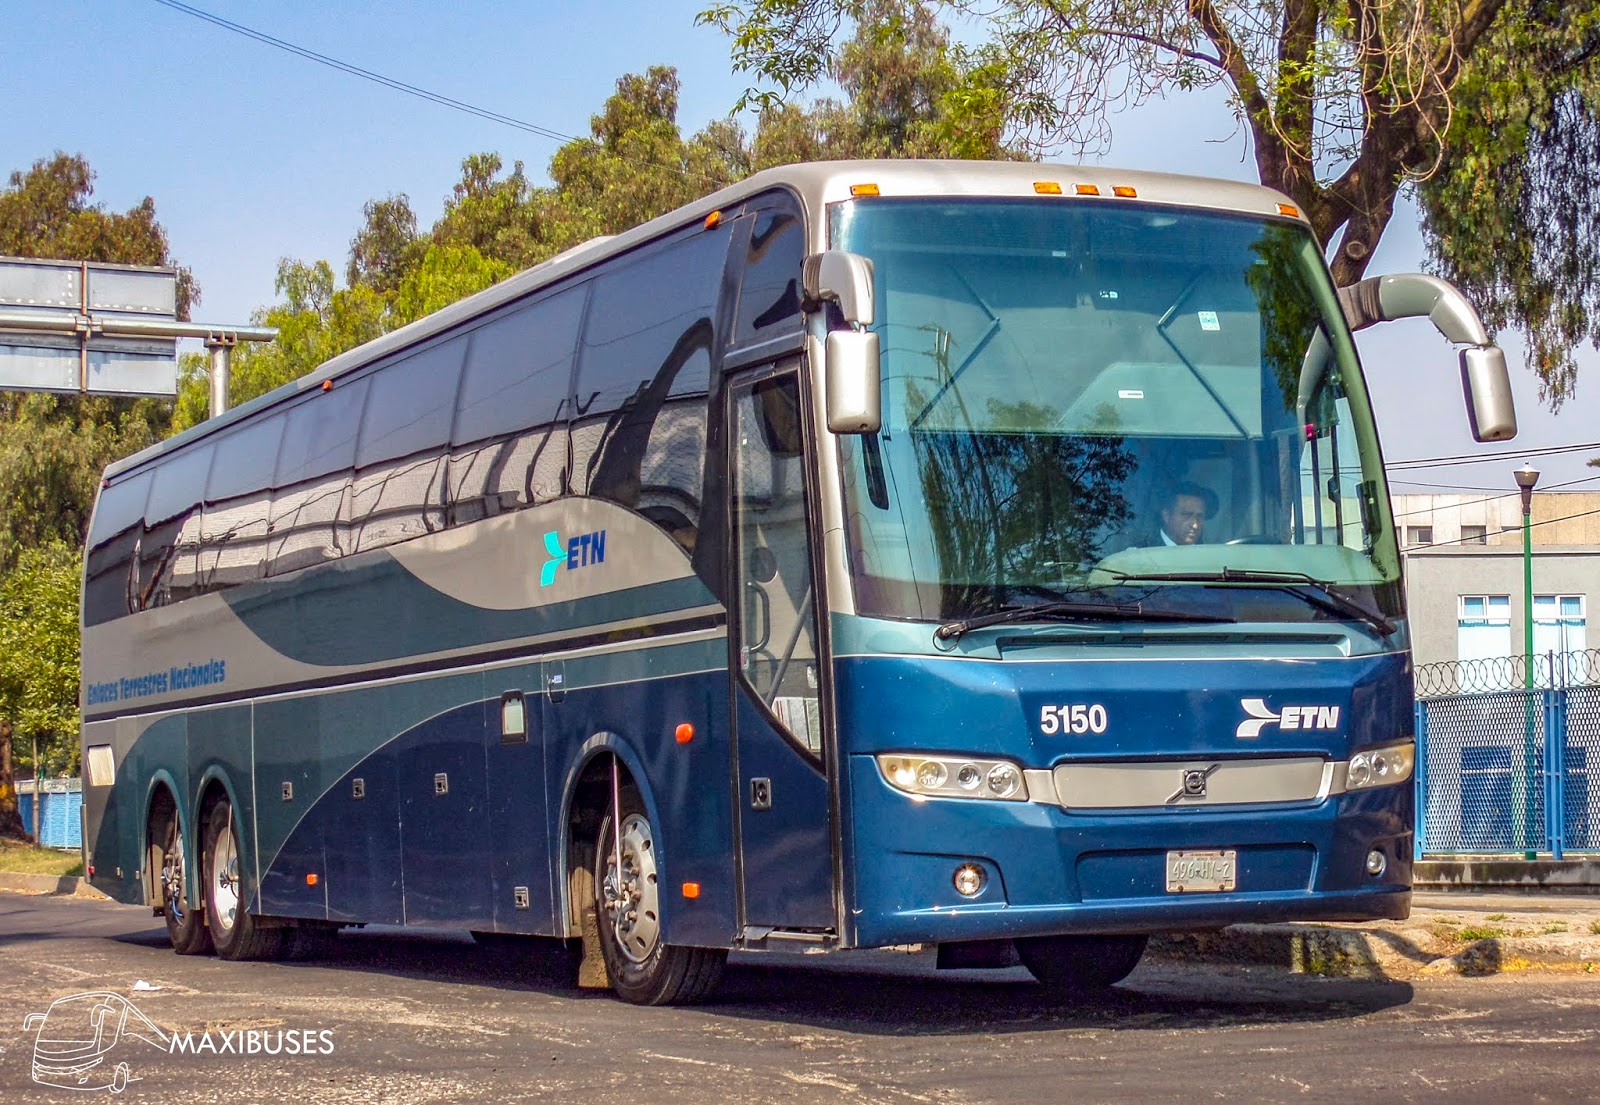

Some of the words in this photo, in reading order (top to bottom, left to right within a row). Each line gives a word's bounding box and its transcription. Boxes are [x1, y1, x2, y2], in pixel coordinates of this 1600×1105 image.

[567, 530, 606, 570] ETN
[88, 682, 118, 705] Enlaces
[120, 672, 168, 699] Terrestres
[170, 659, 225, 690] Nacionales
[1040, 704, 1107, 735] 5150
[1279, 706, 1339, 729] ETN
